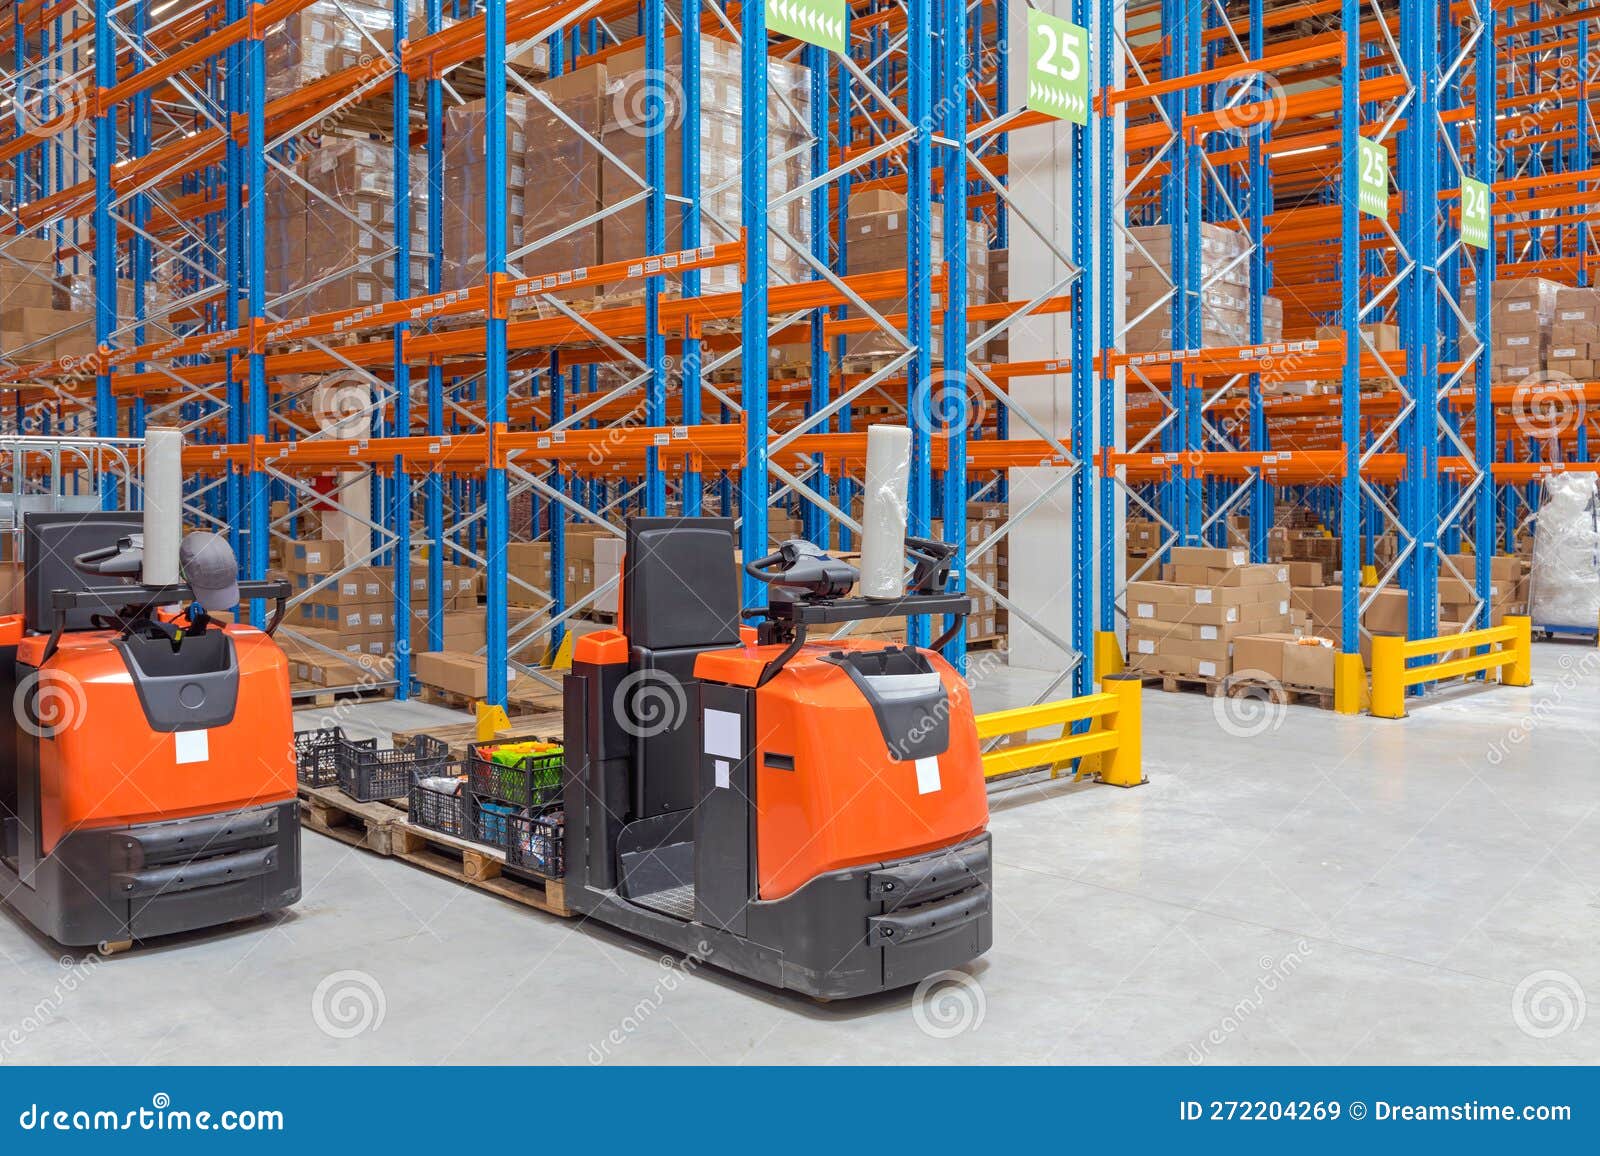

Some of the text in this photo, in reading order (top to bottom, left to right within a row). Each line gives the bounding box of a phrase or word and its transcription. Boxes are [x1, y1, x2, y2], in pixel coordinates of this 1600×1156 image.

[1036, 24, 1081, 81] 25
[1362, 147, 1384, 187] 25
[1466, 185, 1486, 221] 24
